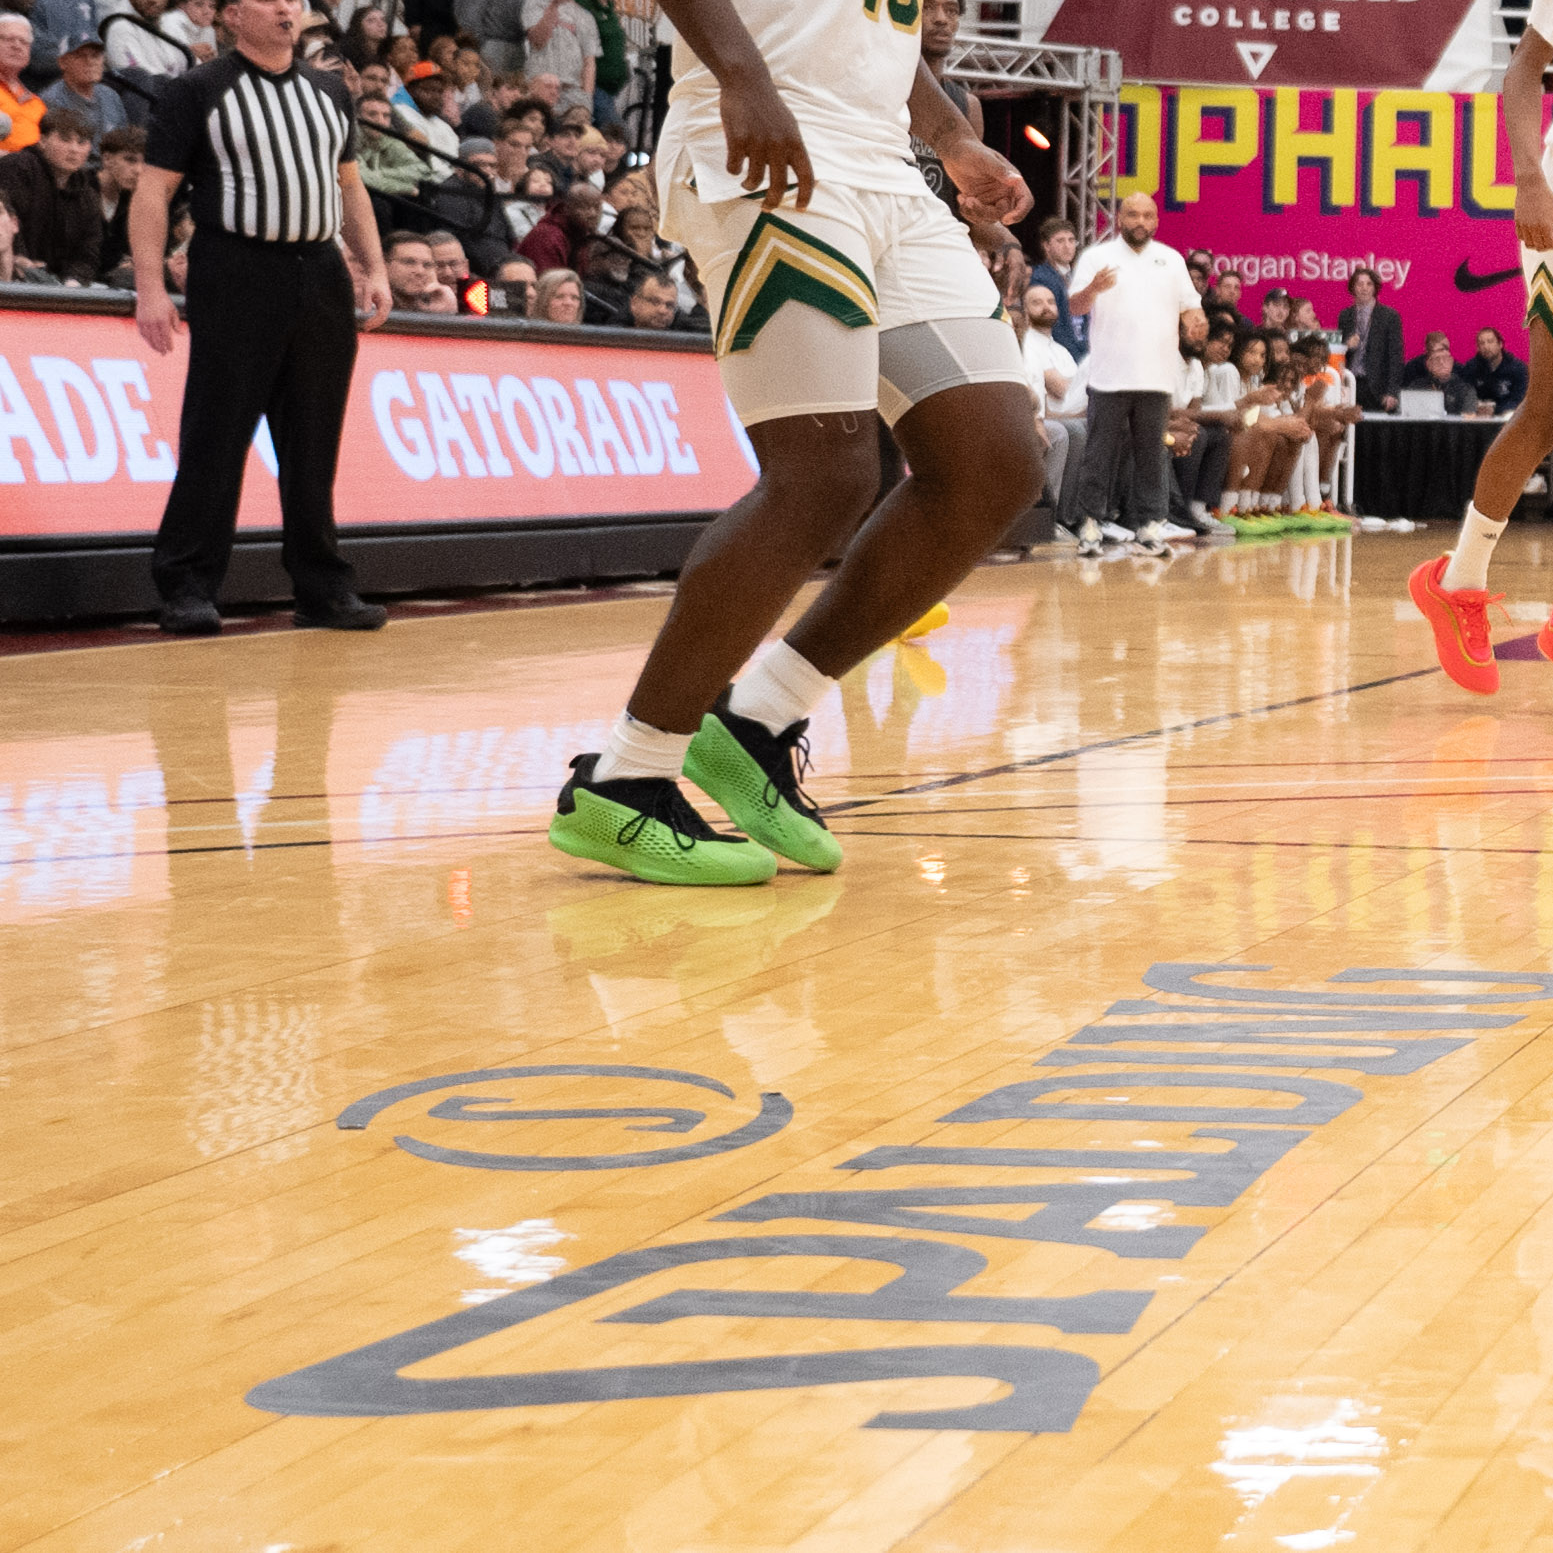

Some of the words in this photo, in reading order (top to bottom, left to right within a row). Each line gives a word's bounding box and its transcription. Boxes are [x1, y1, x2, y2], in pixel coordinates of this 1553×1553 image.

[1173, 5, 1342, 32] COLLEGE
[1189, 249, 1297, 286] organ
[1302, 251, 1412, 290] Stanley
[371, 368, 700, 481] GATORADE
